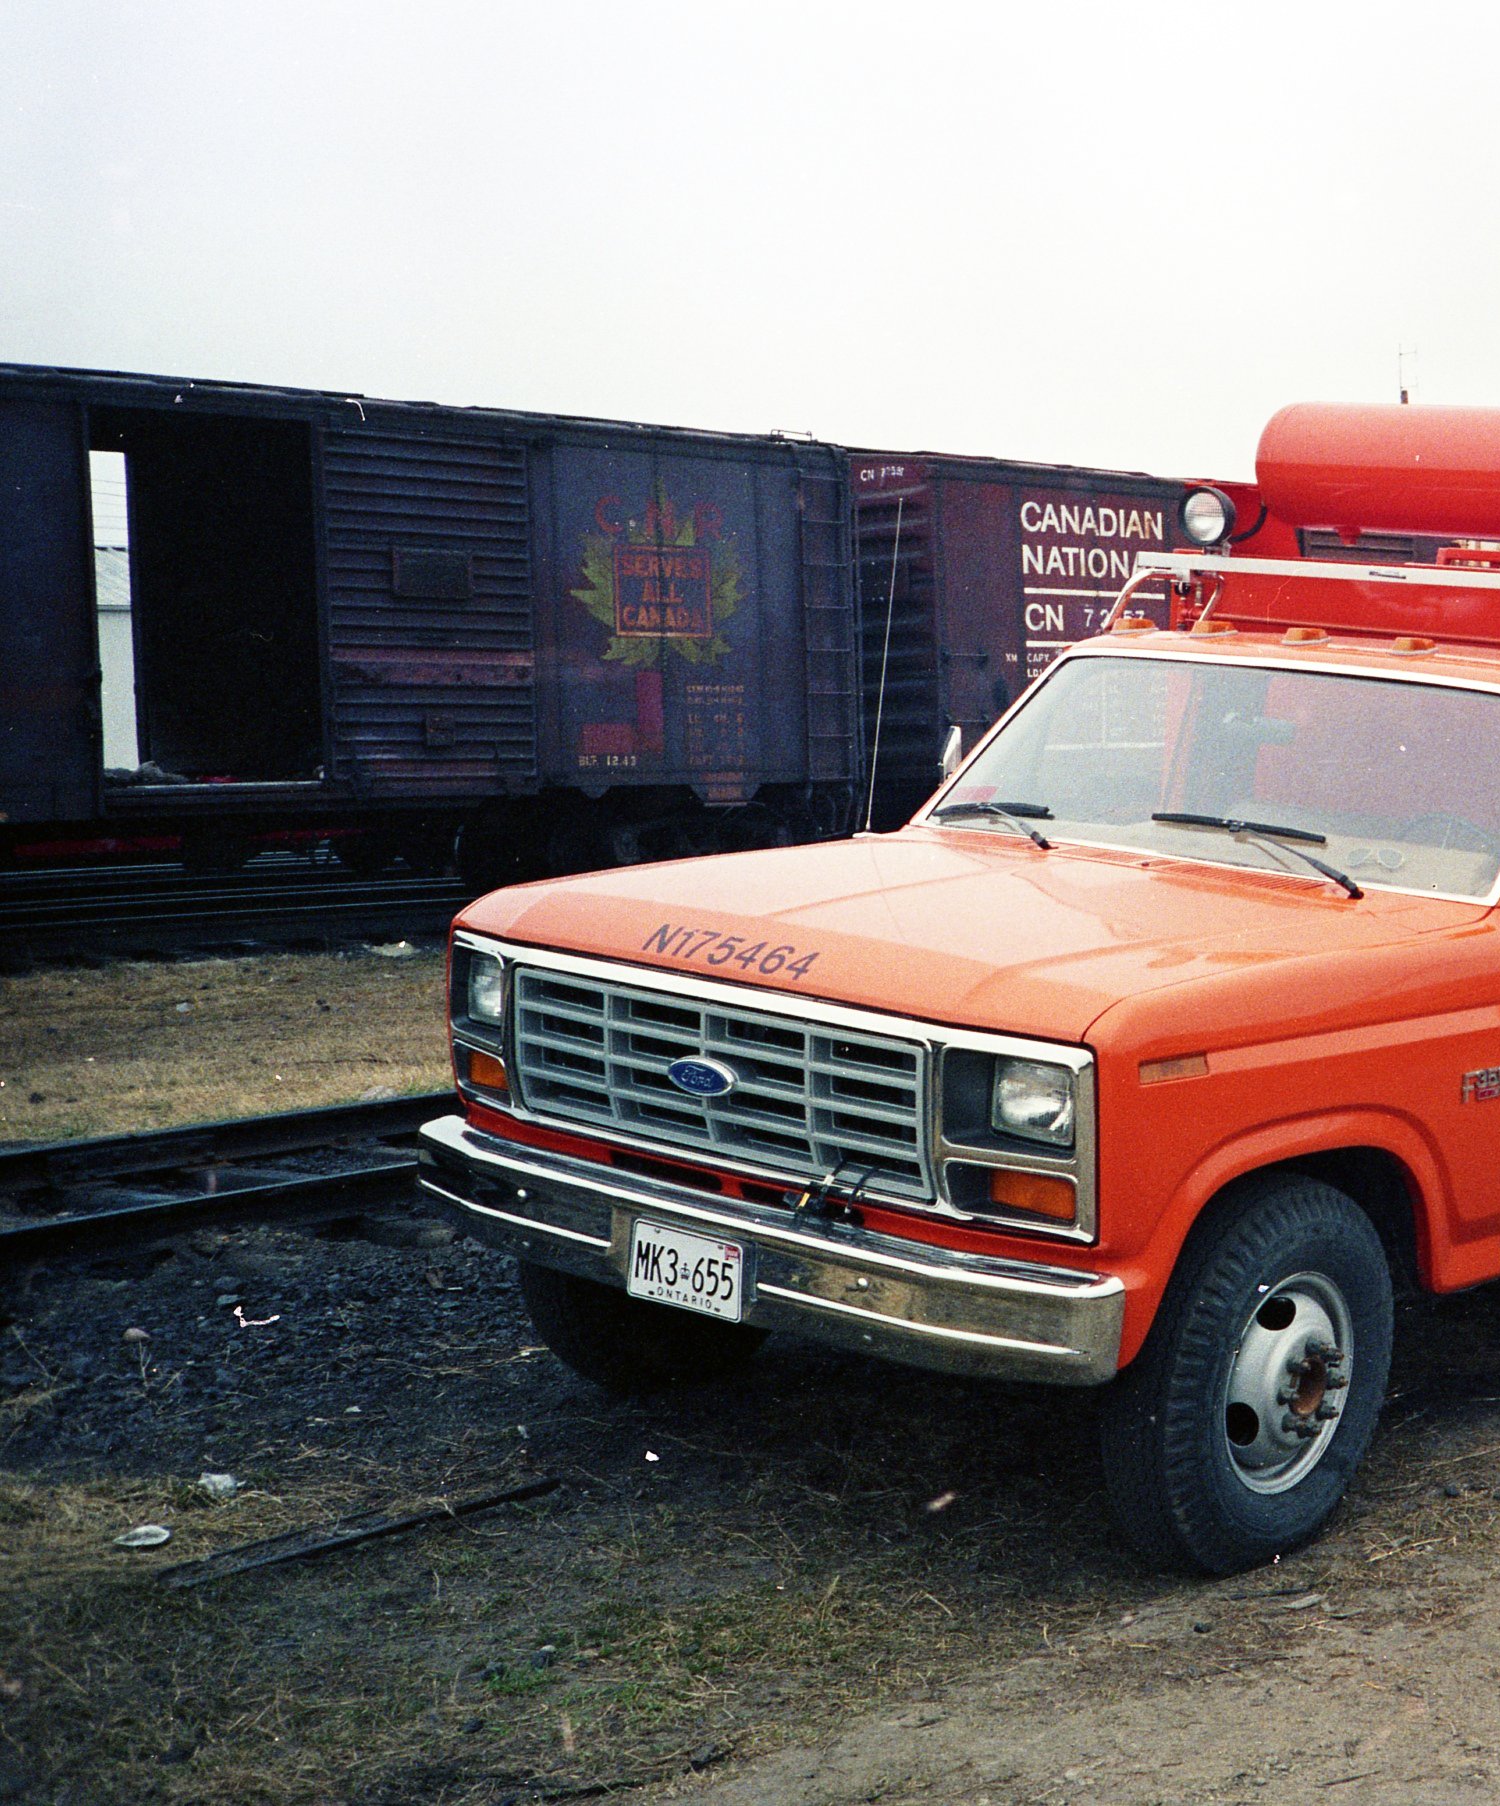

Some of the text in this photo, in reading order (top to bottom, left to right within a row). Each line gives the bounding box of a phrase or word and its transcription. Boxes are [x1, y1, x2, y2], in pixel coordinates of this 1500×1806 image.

[860, 469, 875, 482] CN
[1020, 501, 1163, 540] CANADIAN
[621, 554, 702, 579] SERVES
[1022, 544, 1138, 579] NATION
[641, 580, 685, 605] ALL
[622, 603, 704, 629] CANADA
[1024, 603, 1064, 631] CN
[643, 923, 820, 981] N175464
[682, 1065, 714, 1088] Ford
[634, 1240, 734, 1301] MK3 655
[657, 1286, 712, 1308] ONTARIO
